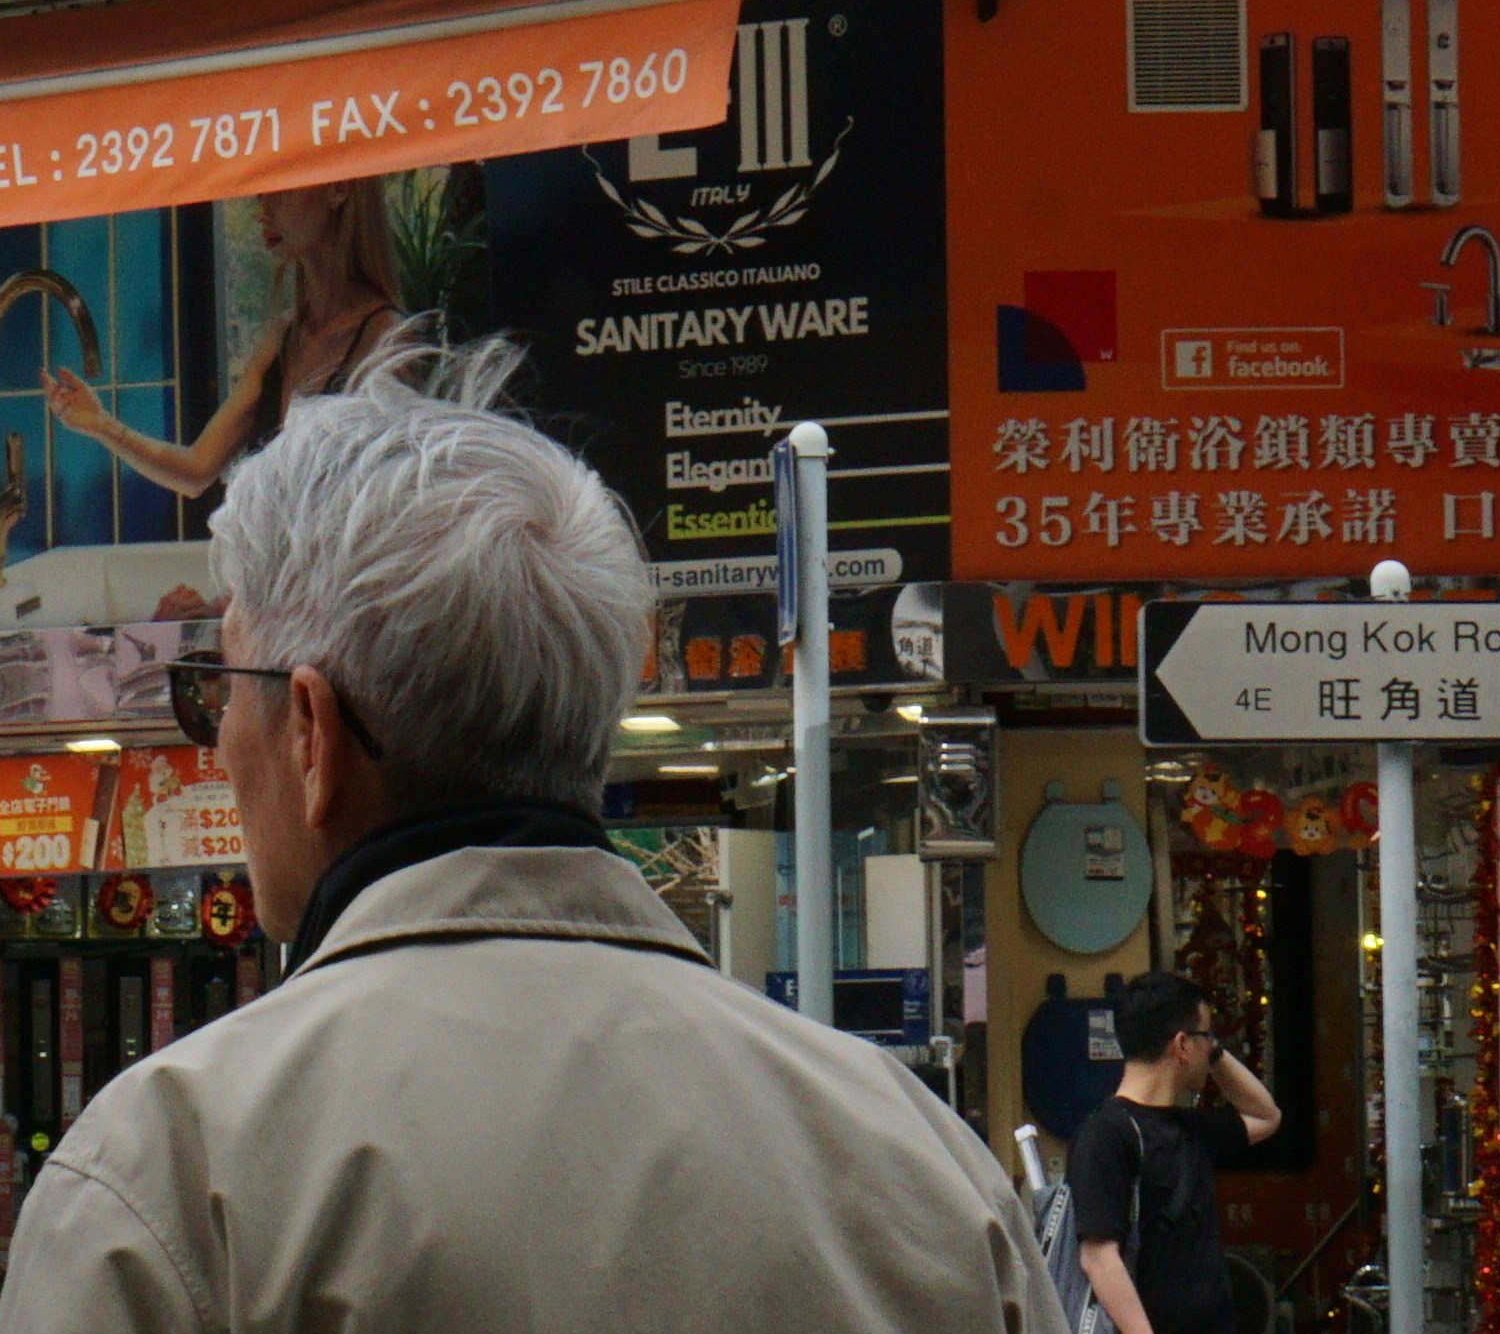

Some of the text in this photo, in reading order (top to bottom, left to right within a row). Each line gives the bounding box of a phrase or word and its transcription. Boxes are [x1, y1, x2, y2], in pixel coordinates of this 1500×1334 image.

[76, 122, 175, 179] 2392
[188, 108, 284, 165] 7871
[446, 67, 564, 129] 2392
[579, 47, 688, 108] 7860
[690, 183, 751, 208] ITALY
[611, 263, 821, 297] STILE CLASSICO ITALIANO
[575, 296, 870, 357] SANITARY WARE
[1226, 354, 1329, 379] facebook
[665, 396, 783, 438] Eternity
[994, 489, 1398, 548] 35年專業承諾
[1245, 621, 1349, 661] Mong
[1363, 620, 1437, 653] Kok
[1235, 687, 1272, 712] 4E
[1318, 677, 1482, 721] 旺角道
[1, 833, 72, 871] $200
